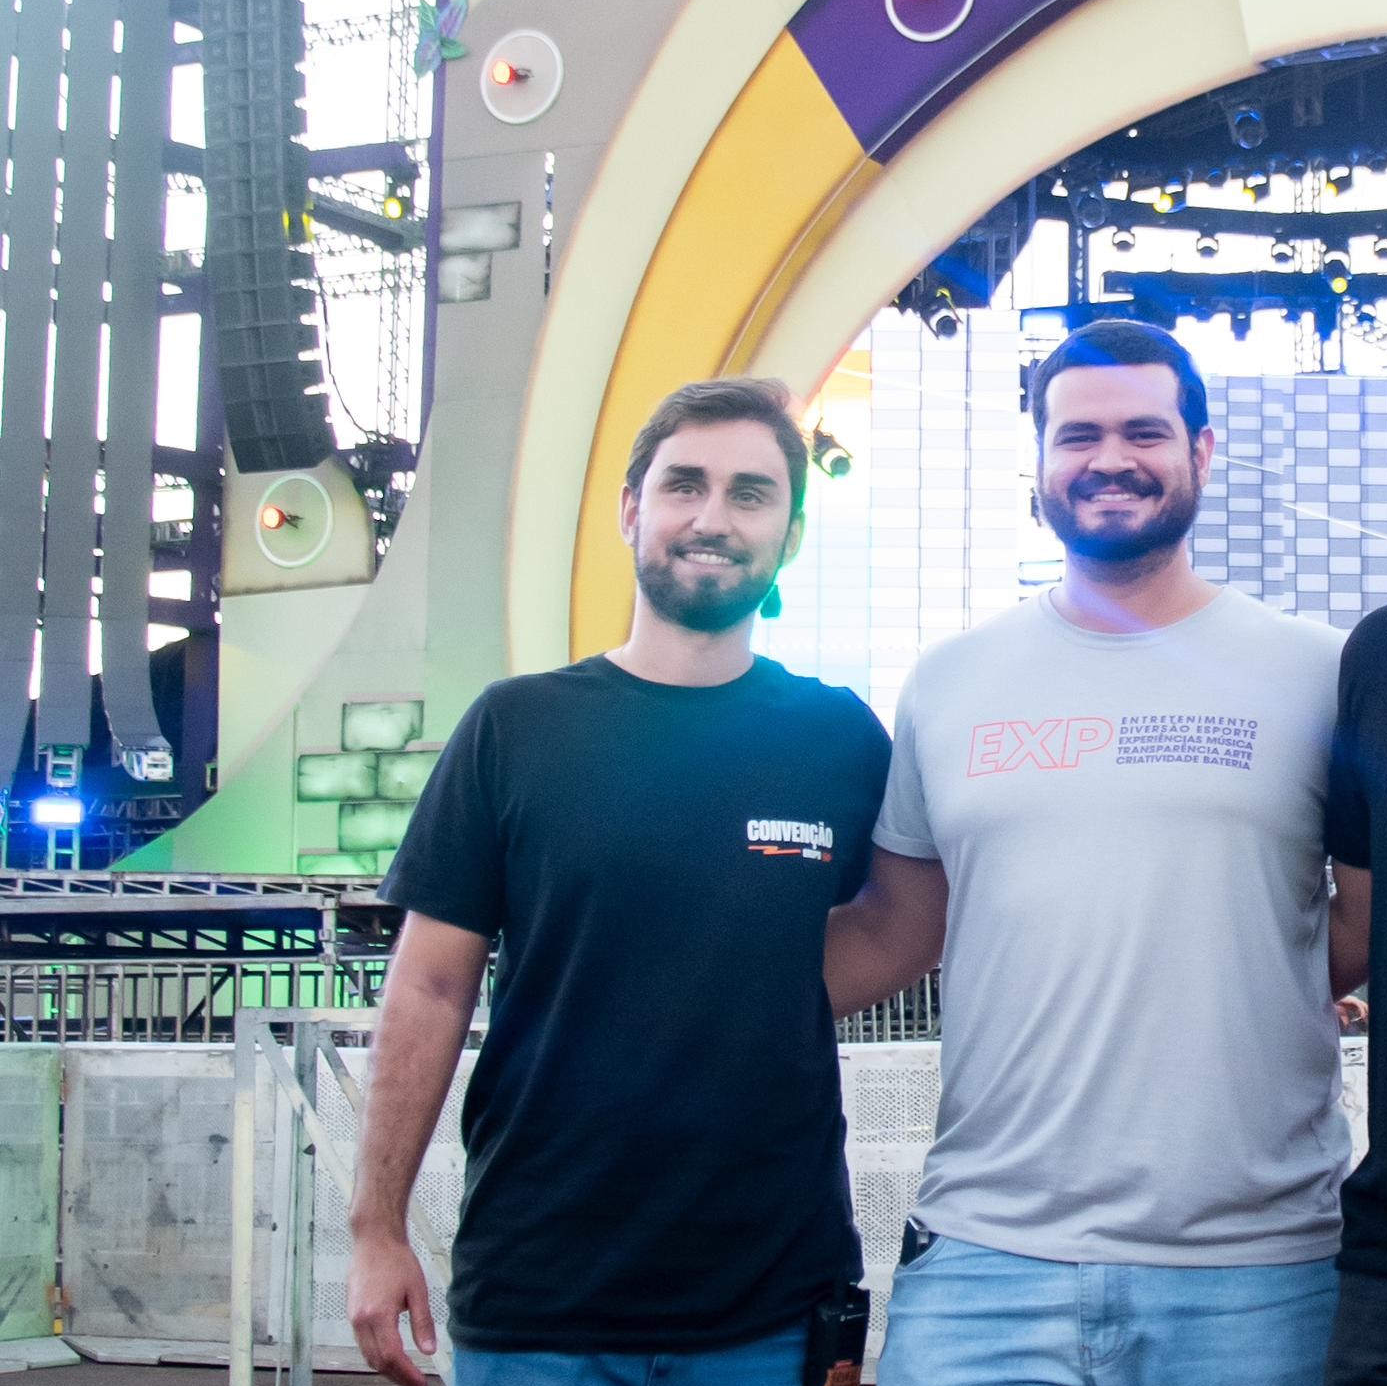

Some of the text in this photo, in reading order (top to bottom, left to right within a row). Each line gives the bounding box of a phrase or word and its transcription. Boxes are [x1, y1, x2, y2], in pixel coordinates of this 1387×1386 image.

[1121, 715, 1258, 729] ENTRETENIMENTO
[1119, 723, 1257, 739] DIVERSÃO ESPORTE
[967, 717, 1115, 778] EXP
[1118, 734, 1253, 750] EXPERIÊNCIAS MÚSICA
[1117, 743, 1253, 761] TRANSPARÊNCIA ARTE
[1116, 754, 1250, 770] CRIATIVIDADE BATERIA
[746, 819, 834, 850] CONVENÇÃO
